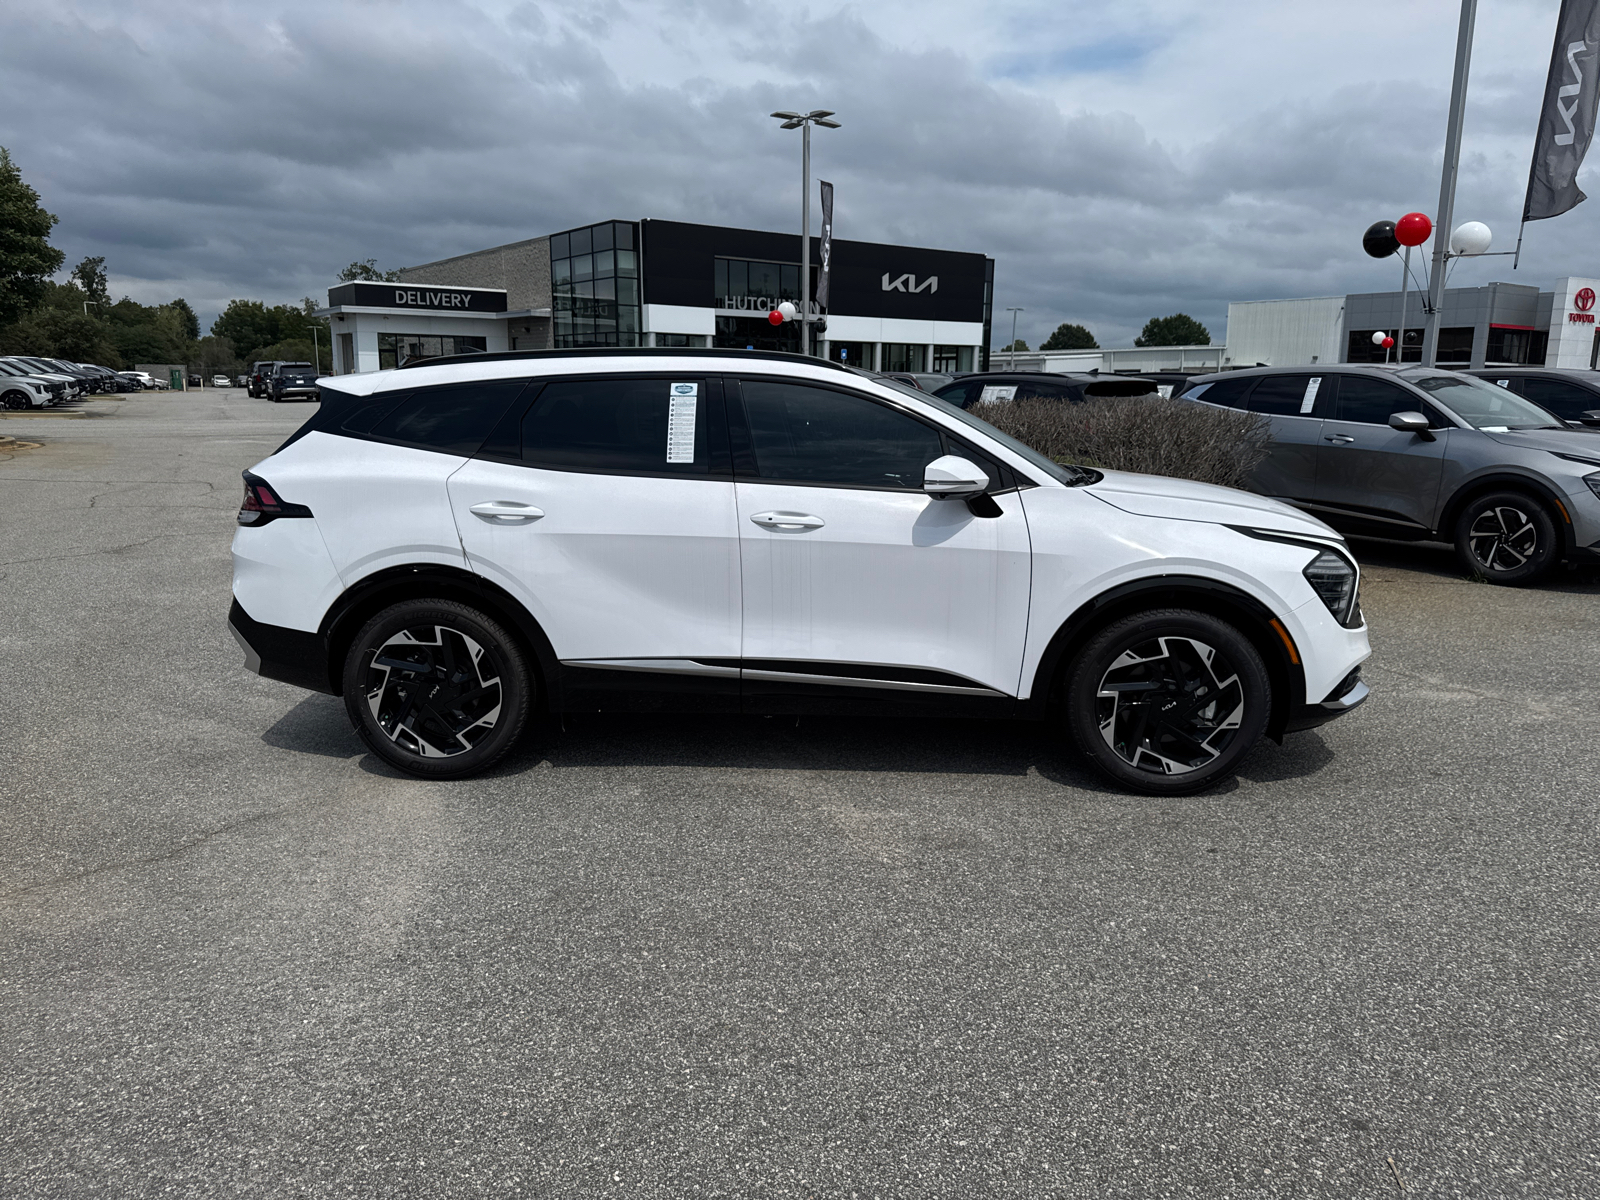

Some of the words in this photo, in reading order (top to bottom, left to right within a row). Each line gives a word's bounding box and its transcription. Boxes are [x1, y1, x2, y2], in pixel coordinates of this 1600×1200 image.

[1554, 40, 1587, 146] KIA
[881, 272, 939, 295] KIA
[395, 290, 472, 308] DELIVERY
[724, 295, 820, 315] HUTCHSN
[1568, 312, 1595, 324] TOYOTA
